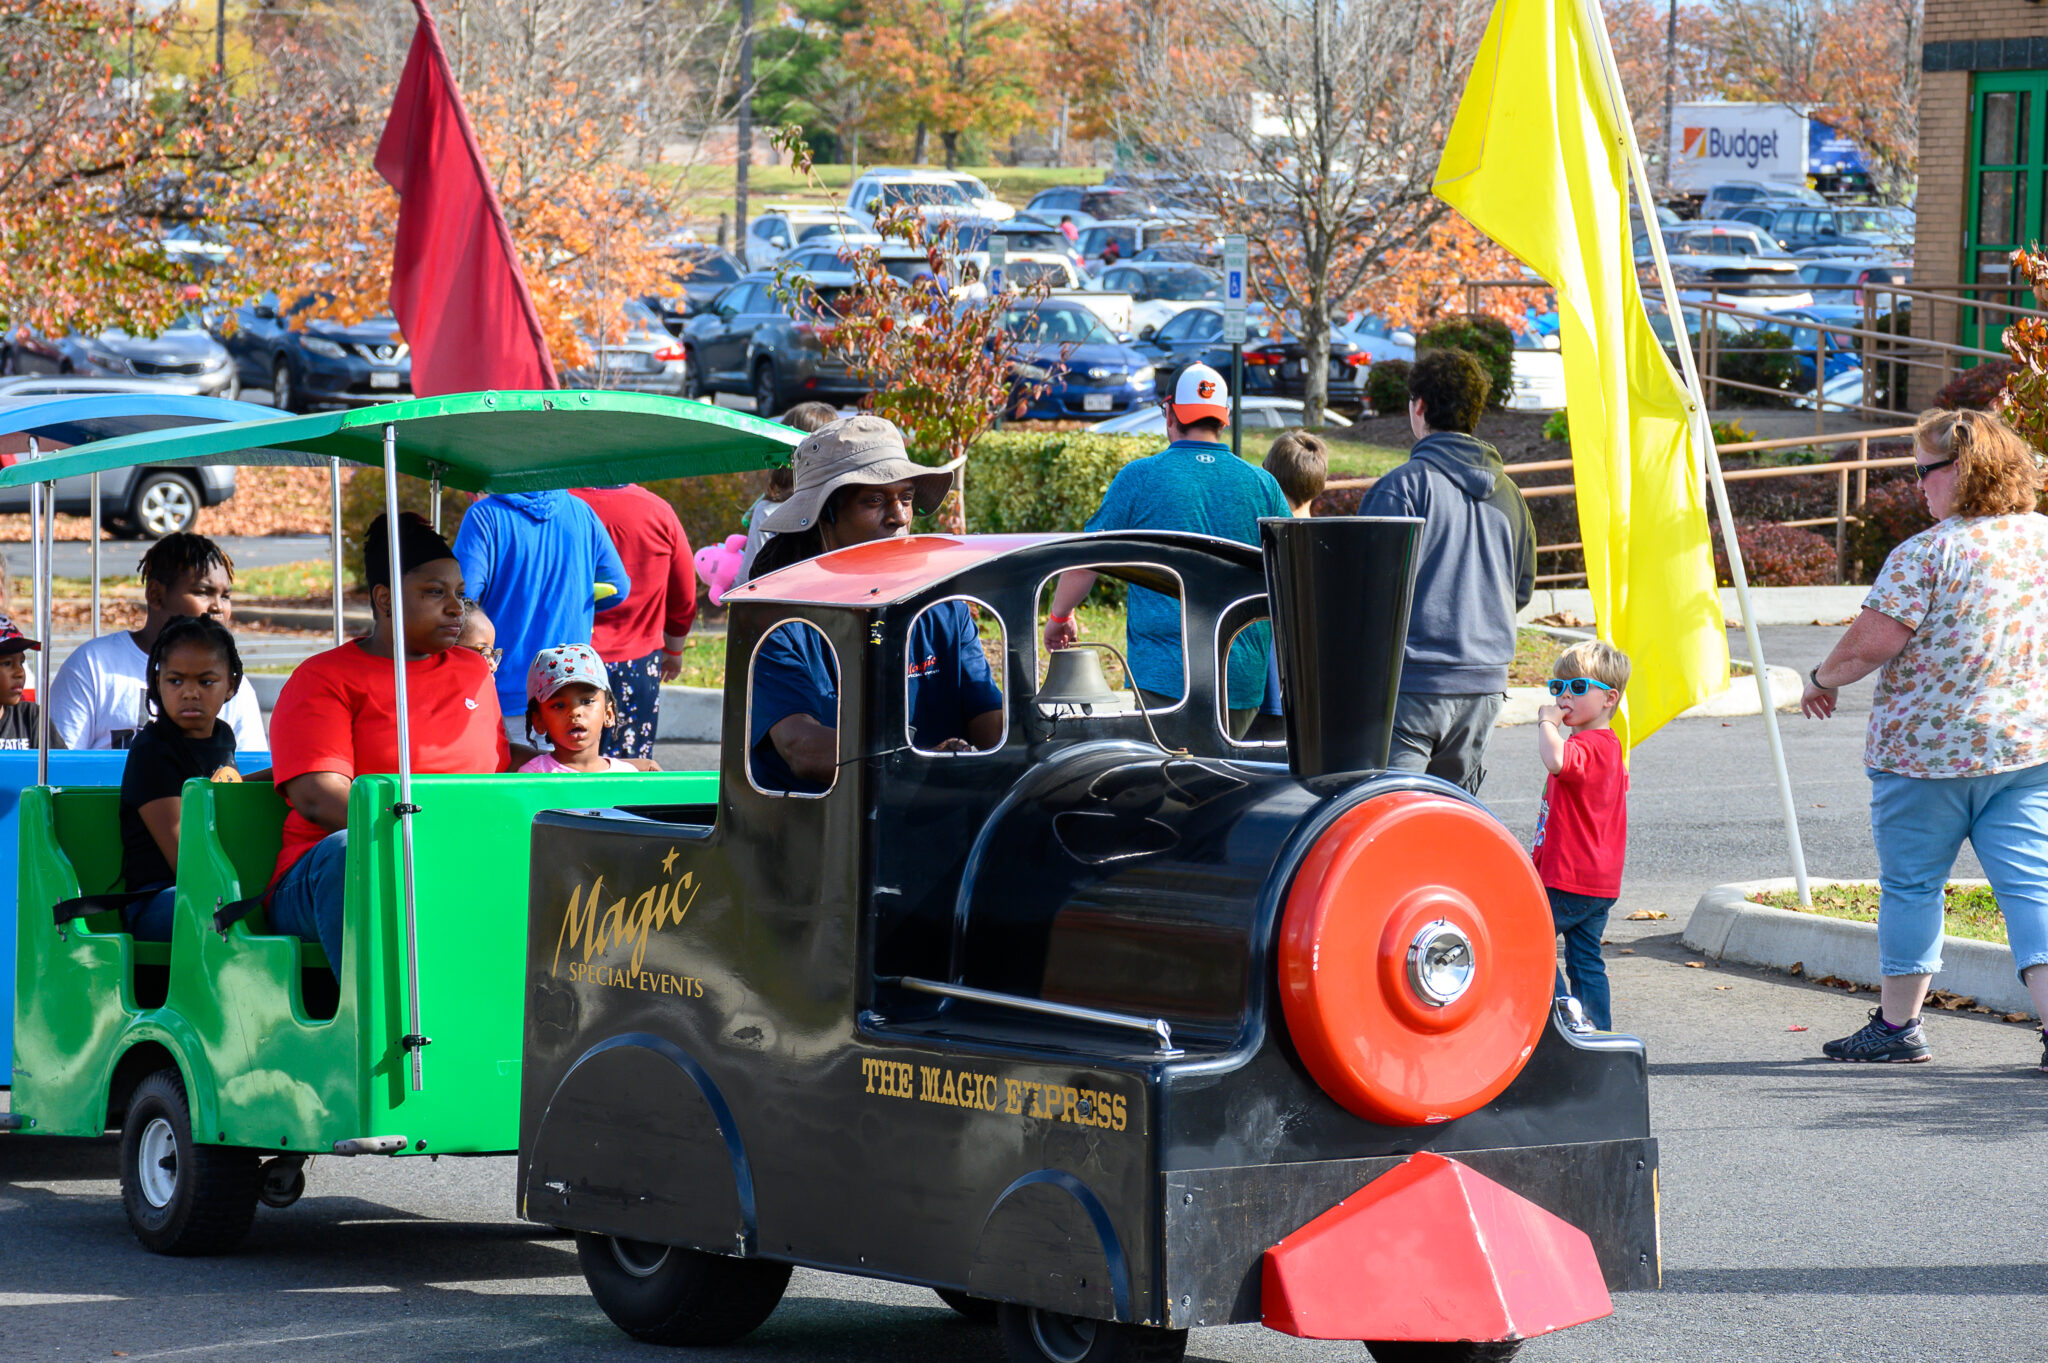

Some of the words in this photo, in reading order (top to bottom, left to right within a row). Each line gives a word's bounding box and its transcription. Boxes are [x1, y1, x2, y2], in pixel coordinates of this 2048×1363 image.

[1709, 127, 1779, 169] Budget
[552, 846, 701, 980] Magic
[569, 961, 634, 989] SPECIAL
[640, 971, 704, 998] EVENTS
[862, 1057, 913, 1099] THE
[920, 1065, 998, 1111] MAGIC
[1004, 1078, 1127, 1131] EXPRESS
